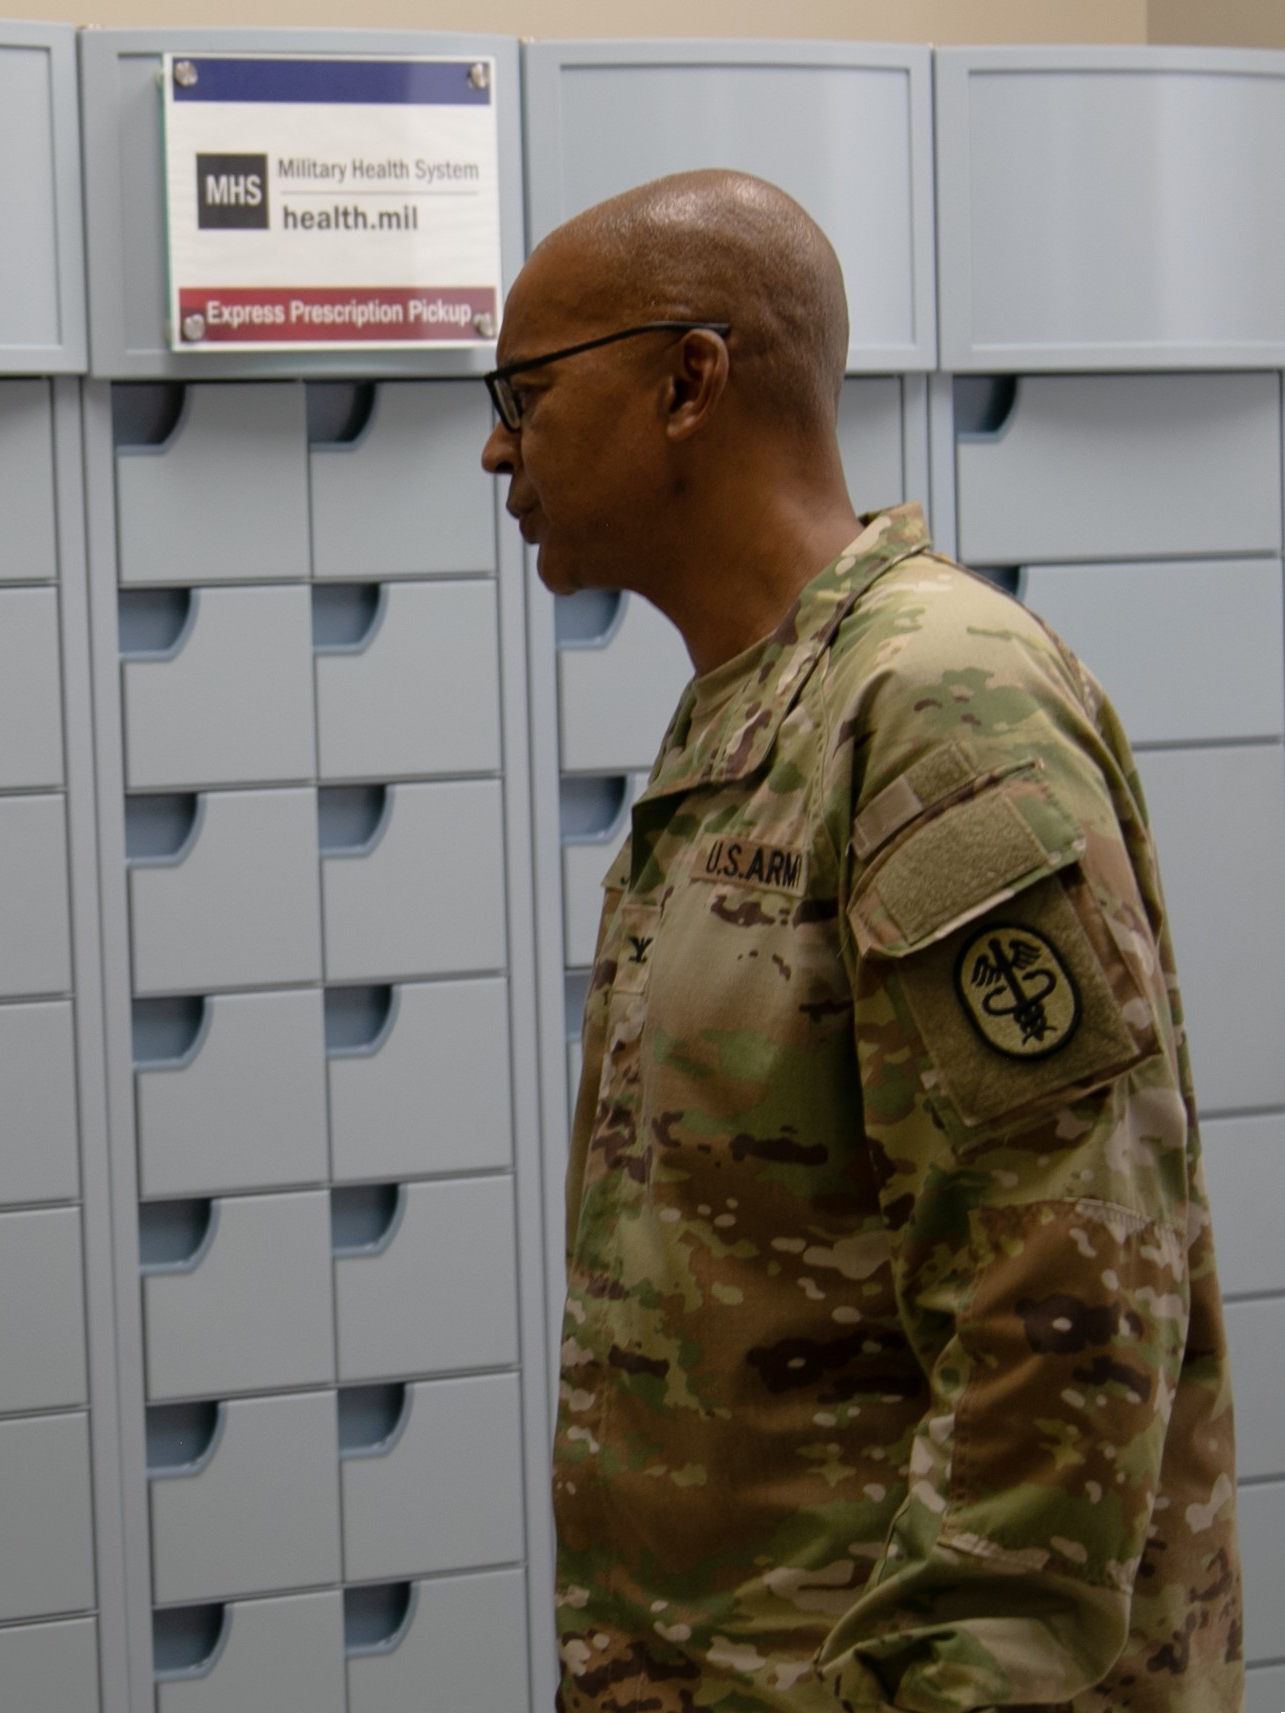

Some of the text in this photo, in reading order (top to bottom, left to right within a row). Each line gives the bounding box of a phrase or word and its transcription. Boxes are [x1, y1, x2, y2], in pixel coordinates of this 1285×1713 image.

[278, 157, 480, 184] Military Health System
[205, 174, 263, 207] MHS
[282, 204, 419, 231] health.mil
[206, 298, 472, 328] Express Prescription Pickup
